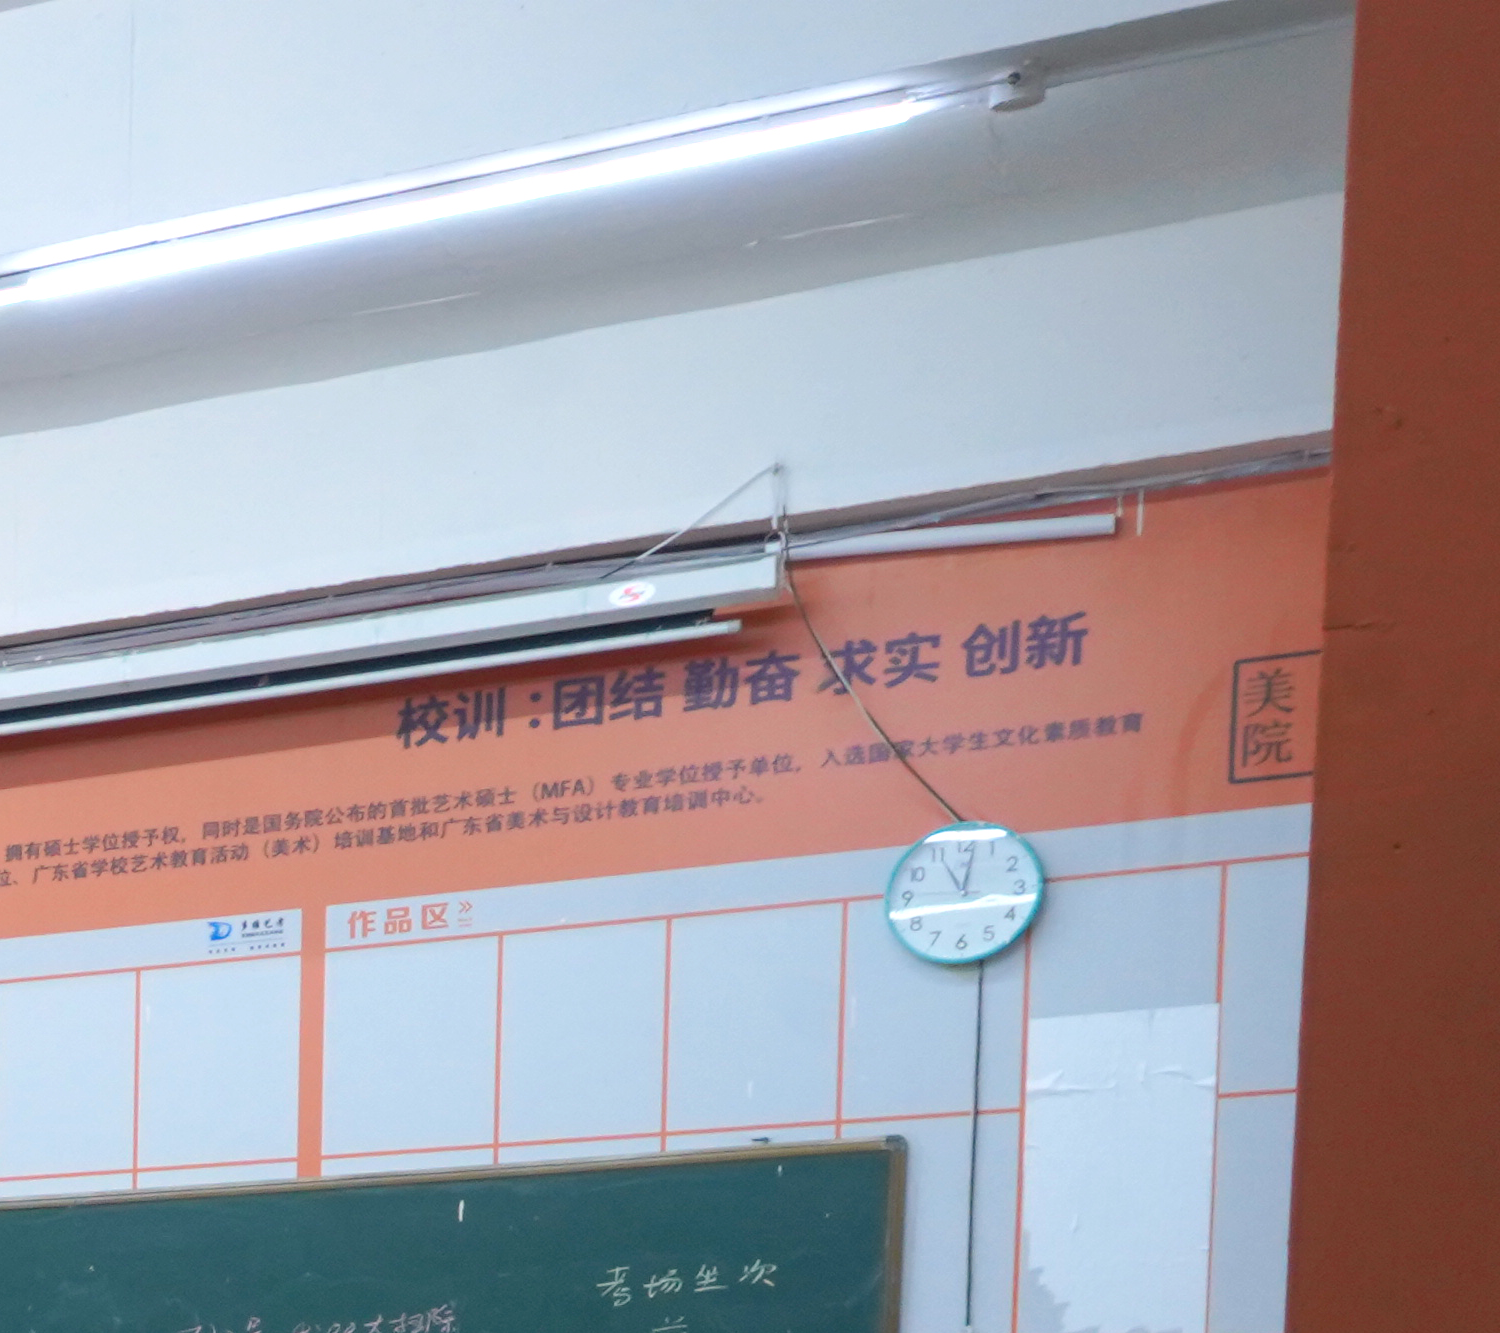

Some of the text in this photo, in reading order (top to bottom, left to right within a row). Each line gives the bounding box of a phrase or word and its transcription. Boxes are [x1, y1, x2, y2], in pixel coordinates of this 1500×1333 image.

[681, 653, 802, 713] 勤奋
[817, 632, 942, 696] 求实
[963, 611, 1089, 679] 创新
[1242, 666, 1297, 768] 美院
[1006, 856, 1018, 872] 2
[910, 867, 925, 882] 10
[1013, 880, 1026, 896] 3
[901, 891, 914, 906] 9
[347, 902, 449, 939] 作品区
[1004, 906, 1016, 921] 4
[910, 917, 922, 931] 8
[930, 931, 942, 946] 7
[983, 925, 995, 941] 5
[955, 934, 968, 950] 6
